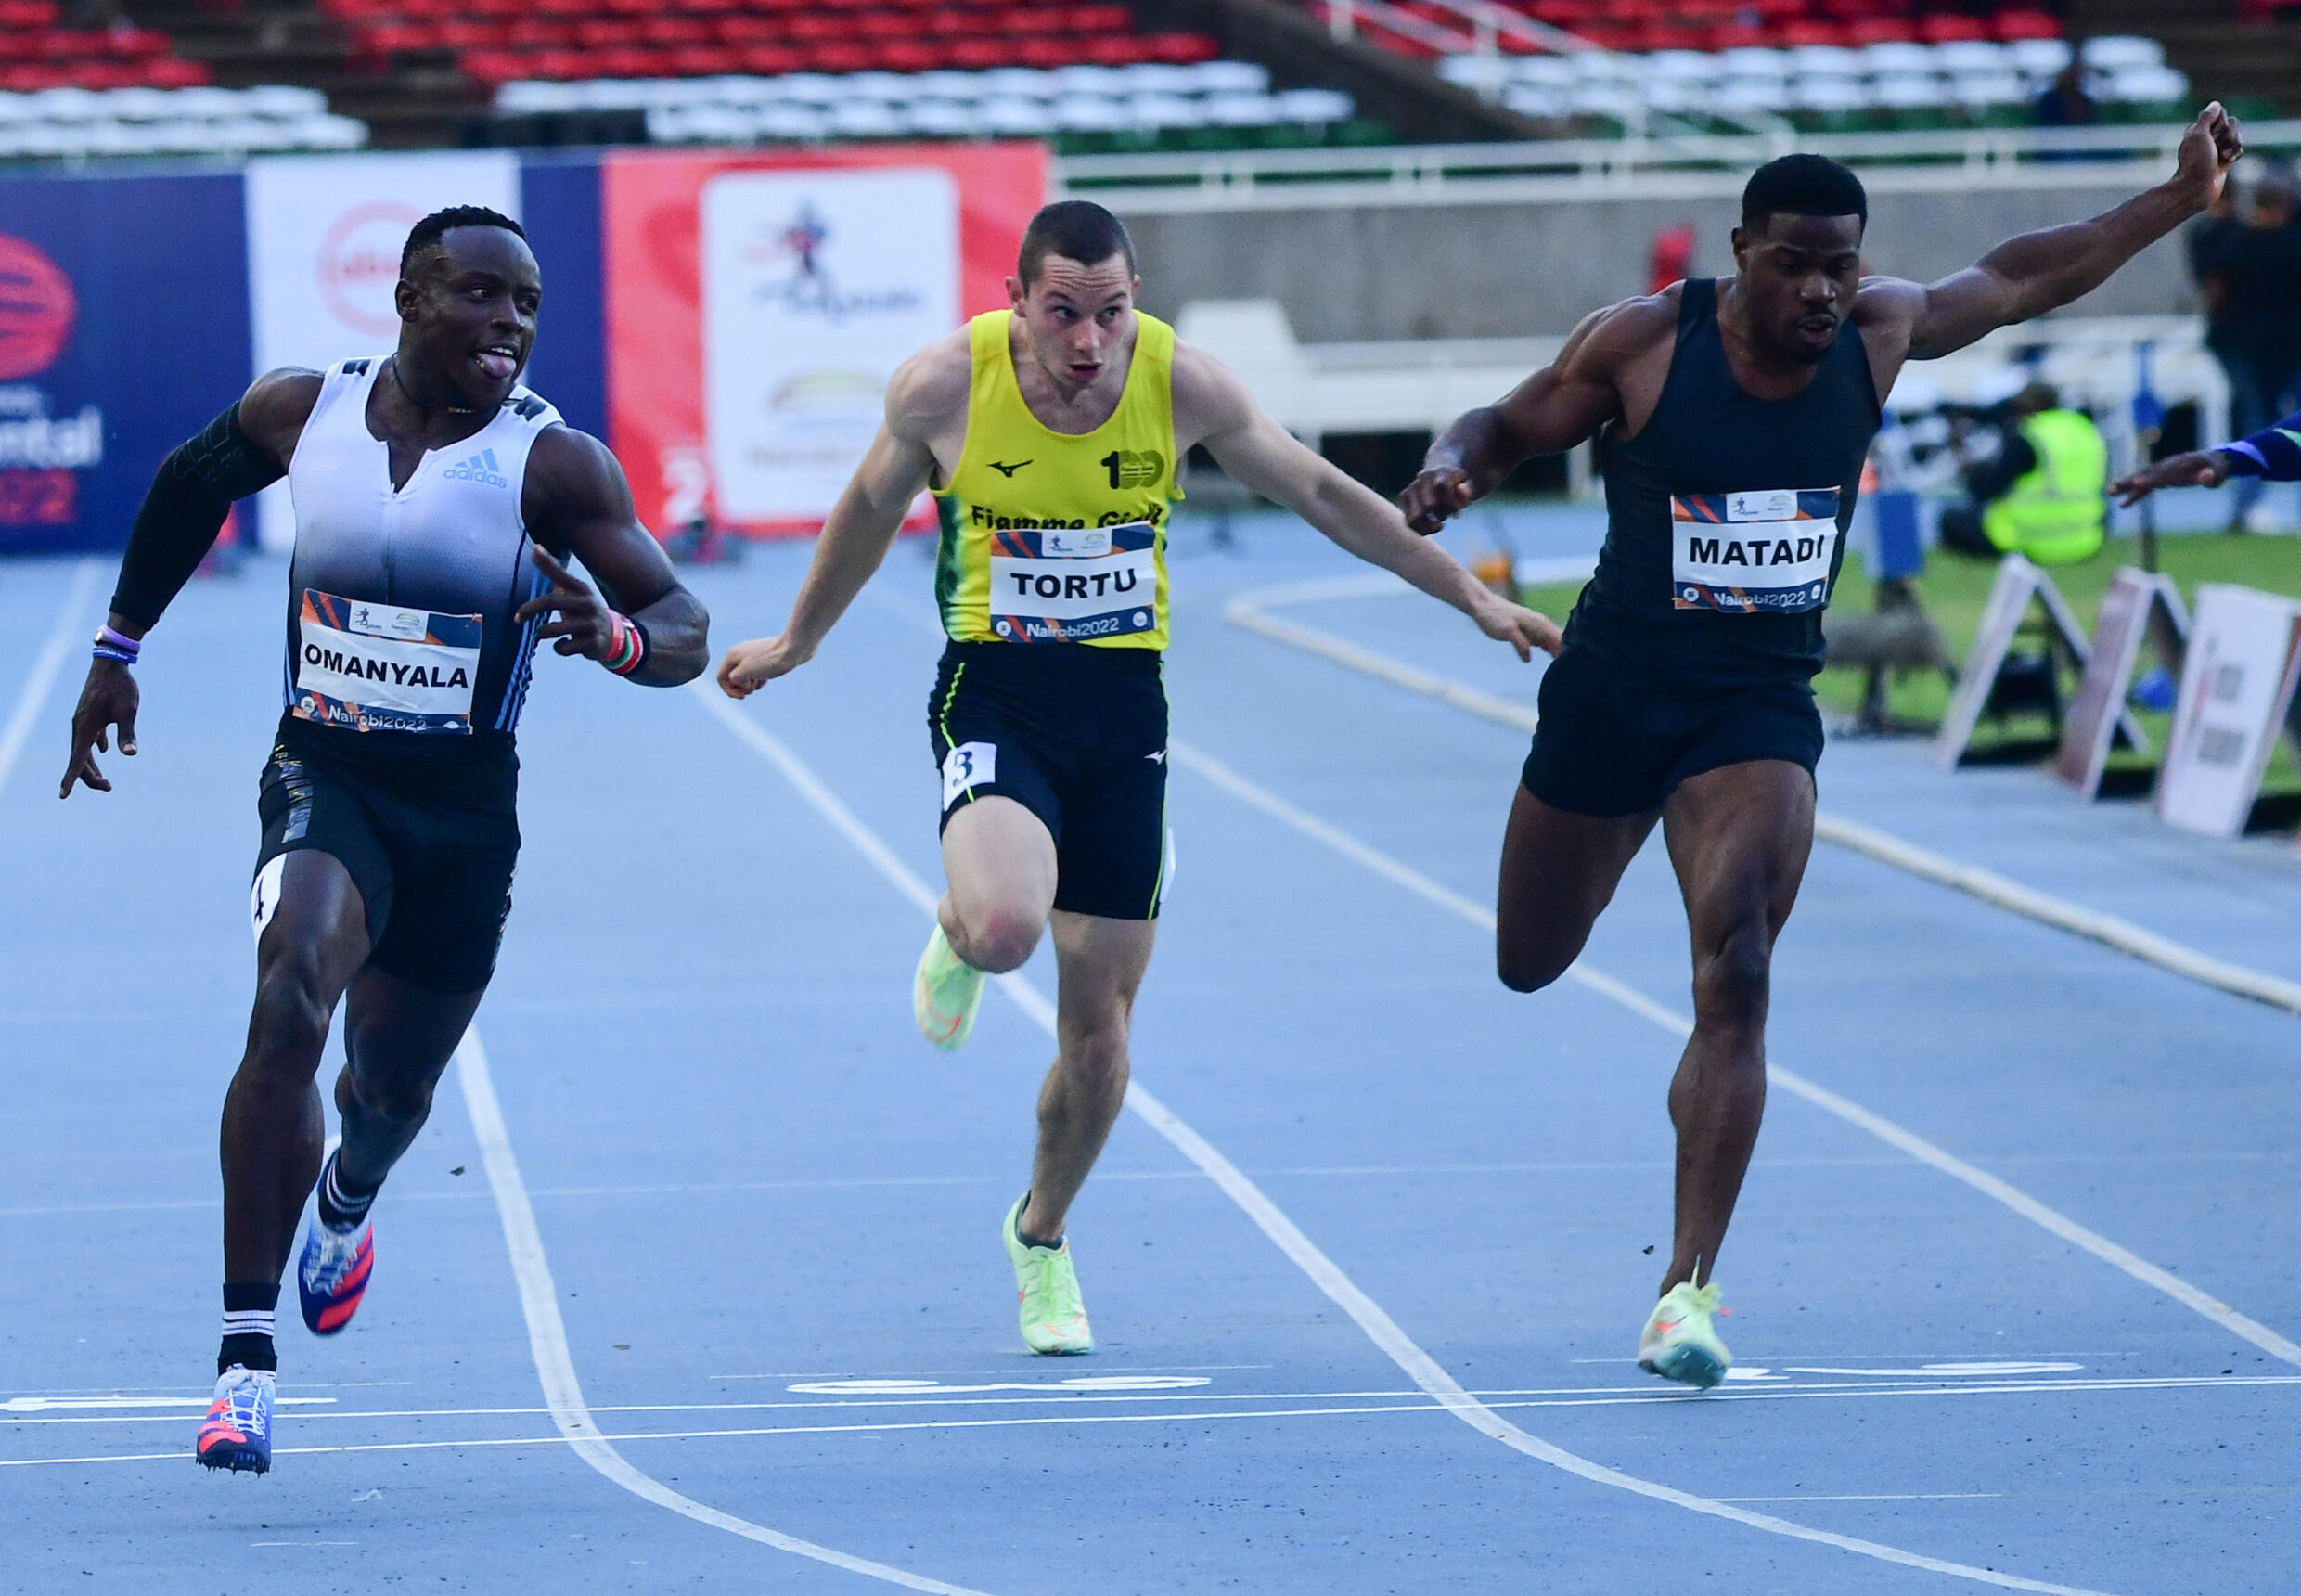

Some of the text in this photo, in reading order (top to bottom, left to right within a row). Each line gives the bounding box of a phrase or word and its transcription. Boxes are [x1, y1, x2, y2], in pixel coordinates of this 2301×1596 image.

[443, 467, 508, 489] adidas
[1689, 534, 1825, 567] MATADI
[1009, 568, 1137, 599] TORTU
[1713, 590, 1806, 608] Nairobi2022
[1026, 617, 1120, 638] Nairobi2022
[304, 643, 469, 689] OMANYALA
[328, 704, 427, 732] Nairobi2022
[952, 751, 973, 788] 3
